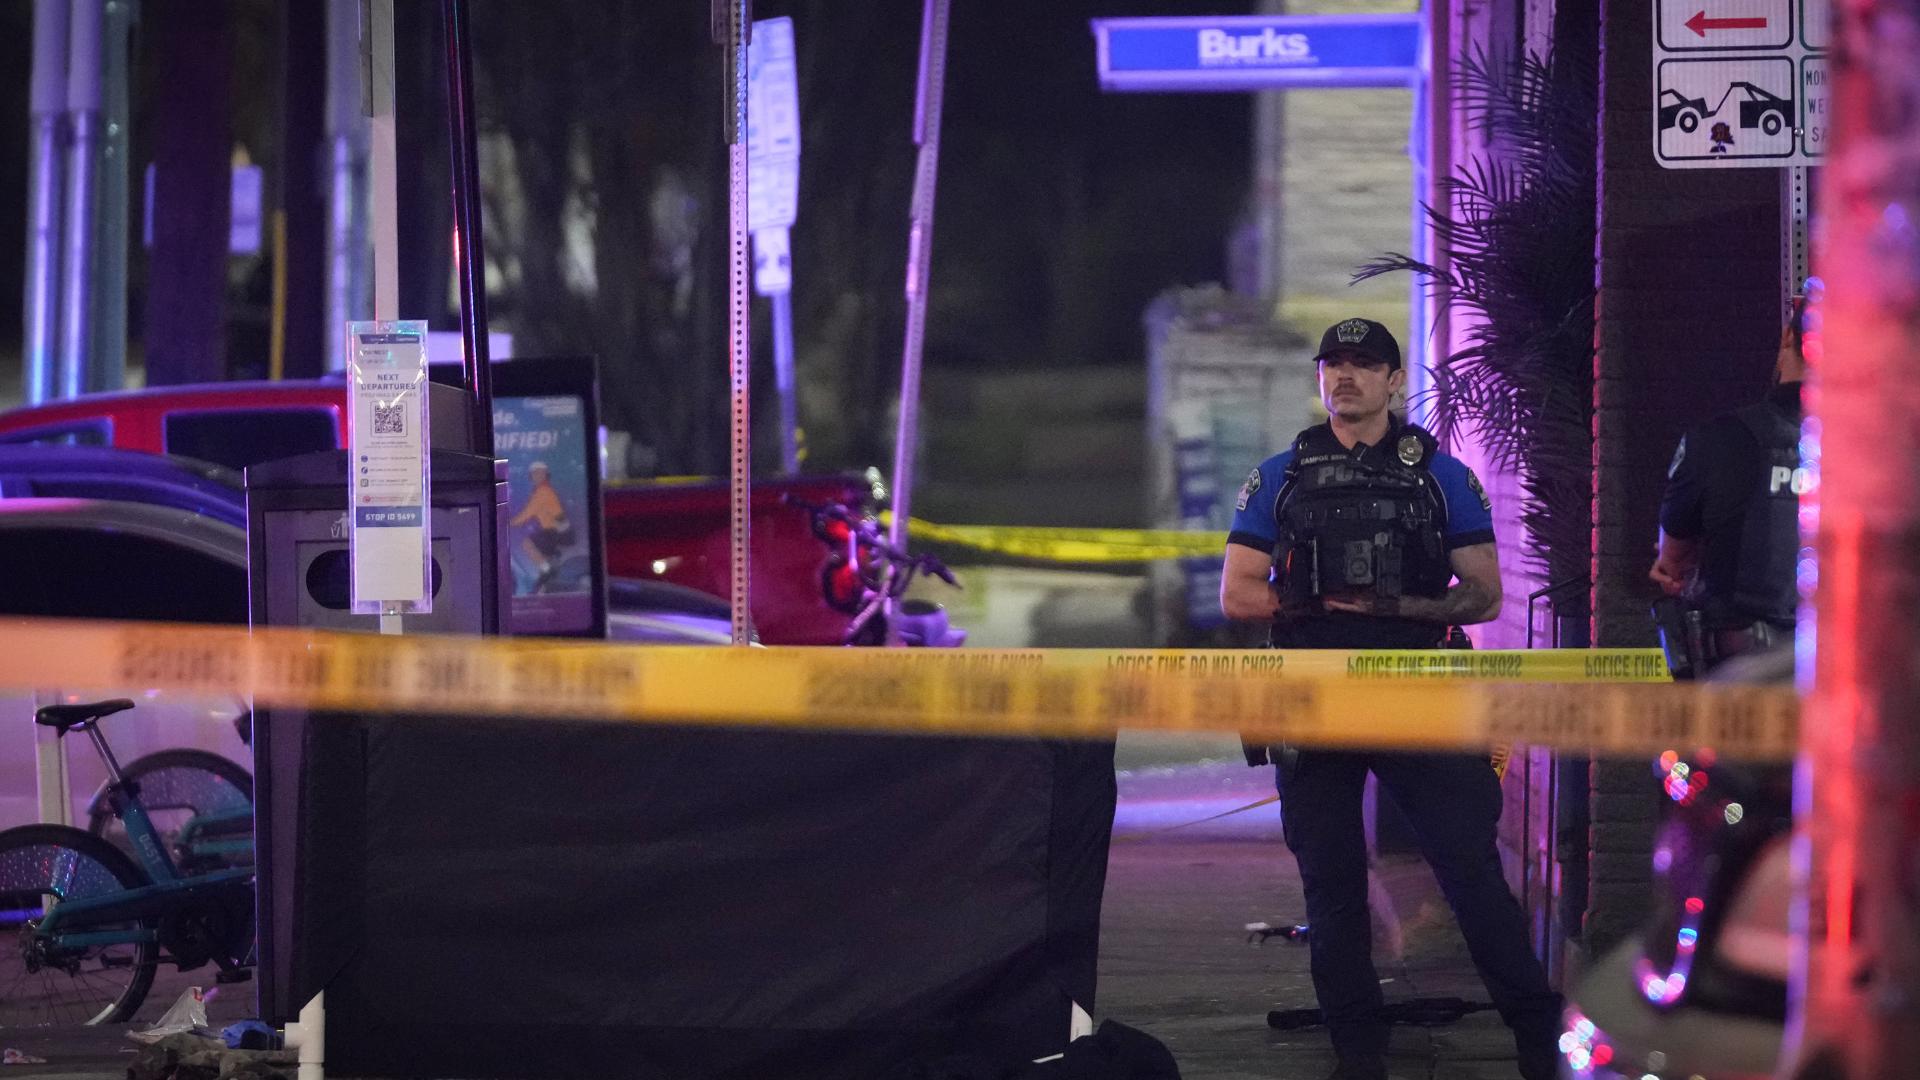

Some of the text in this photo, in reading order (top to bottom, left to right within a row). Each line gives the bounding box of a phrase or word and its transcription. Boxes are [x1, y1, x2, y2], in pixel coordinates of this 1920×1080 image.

[1198, 27, 1309, 58] Burks
[377, 373, 400, 381] NEXT
[360, 383, 416, 391] DEPARTURES
[365, 513, 386, 521] STOP
